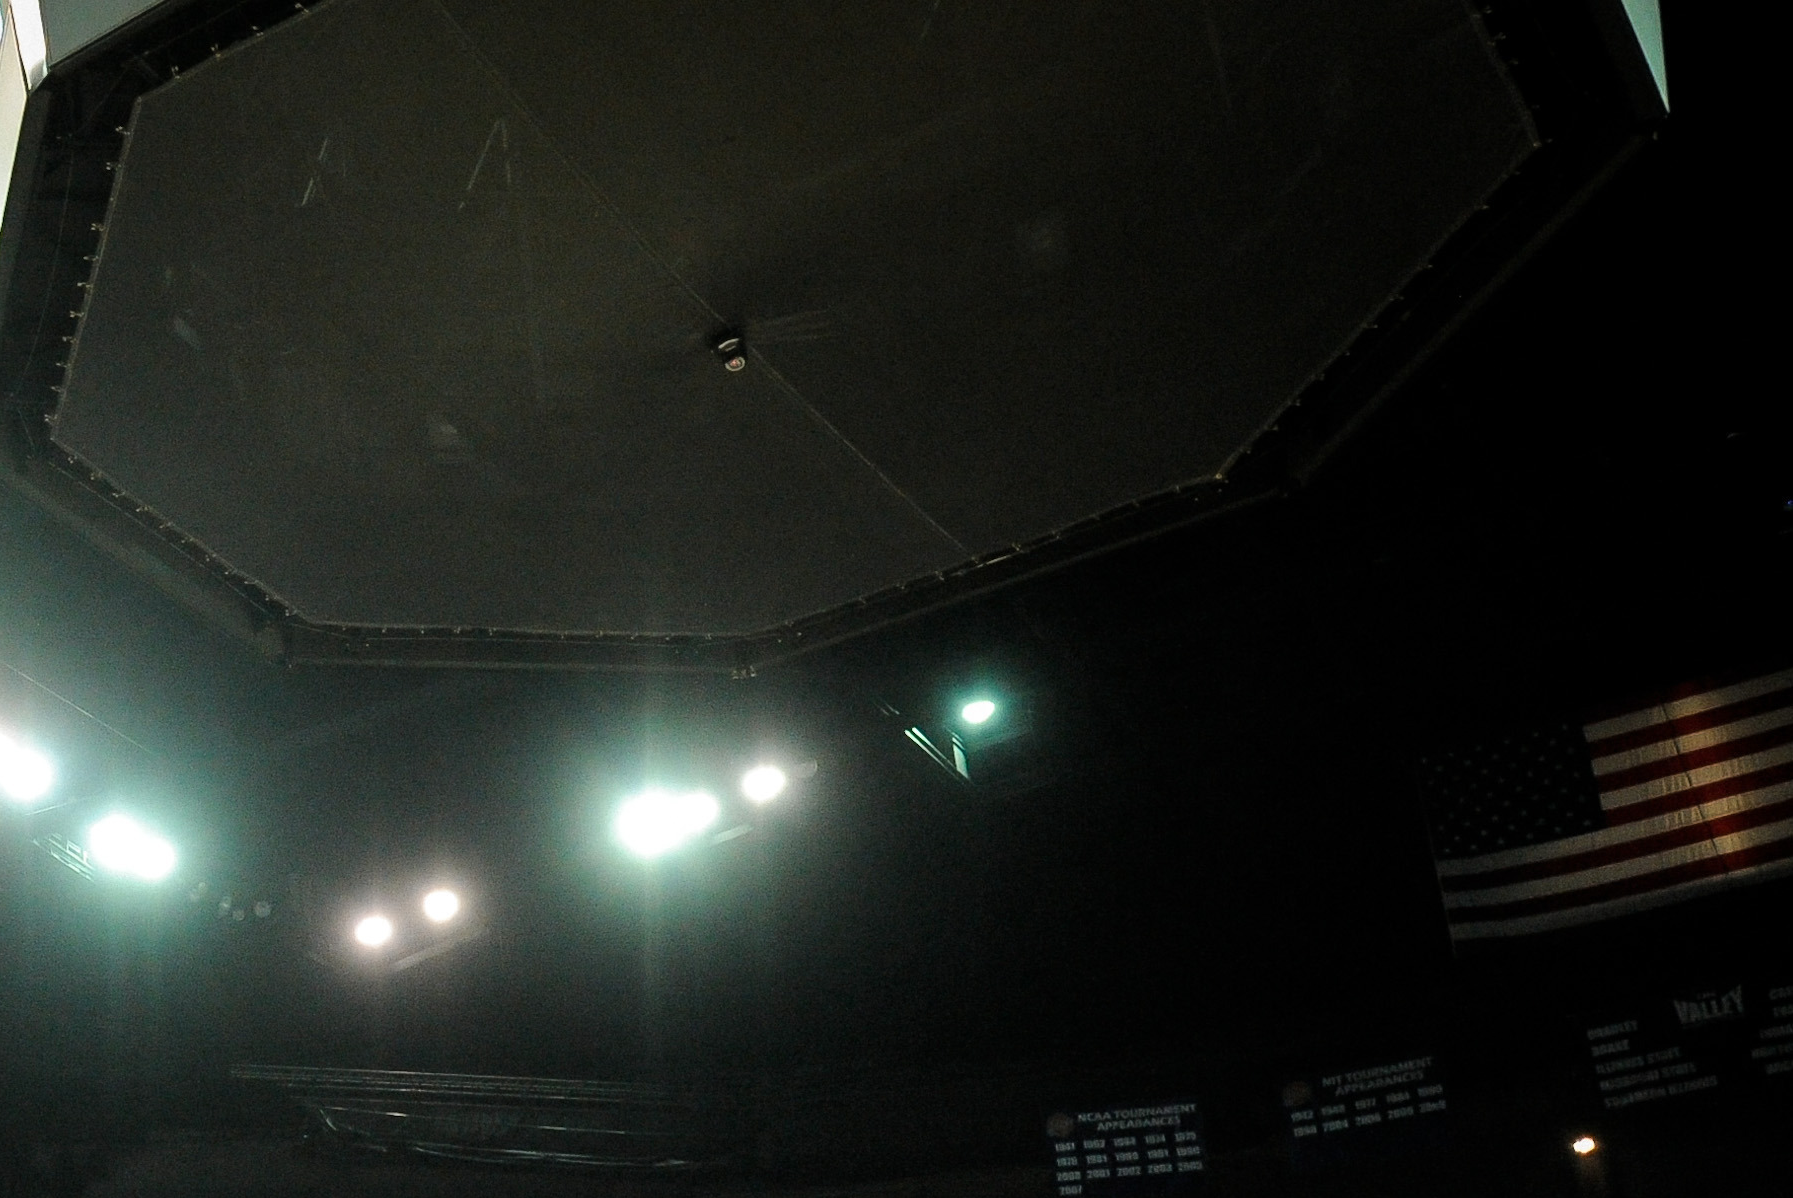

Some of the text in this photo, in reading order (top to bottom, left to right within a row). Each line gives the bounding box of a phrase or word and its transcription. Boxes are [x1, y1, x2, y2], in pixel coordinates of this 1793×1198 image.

[1078, 1103, 1197, 1122] NCAA TOURNAMENT
[1097, 1116, 1181, 1131] APPEARANCES
